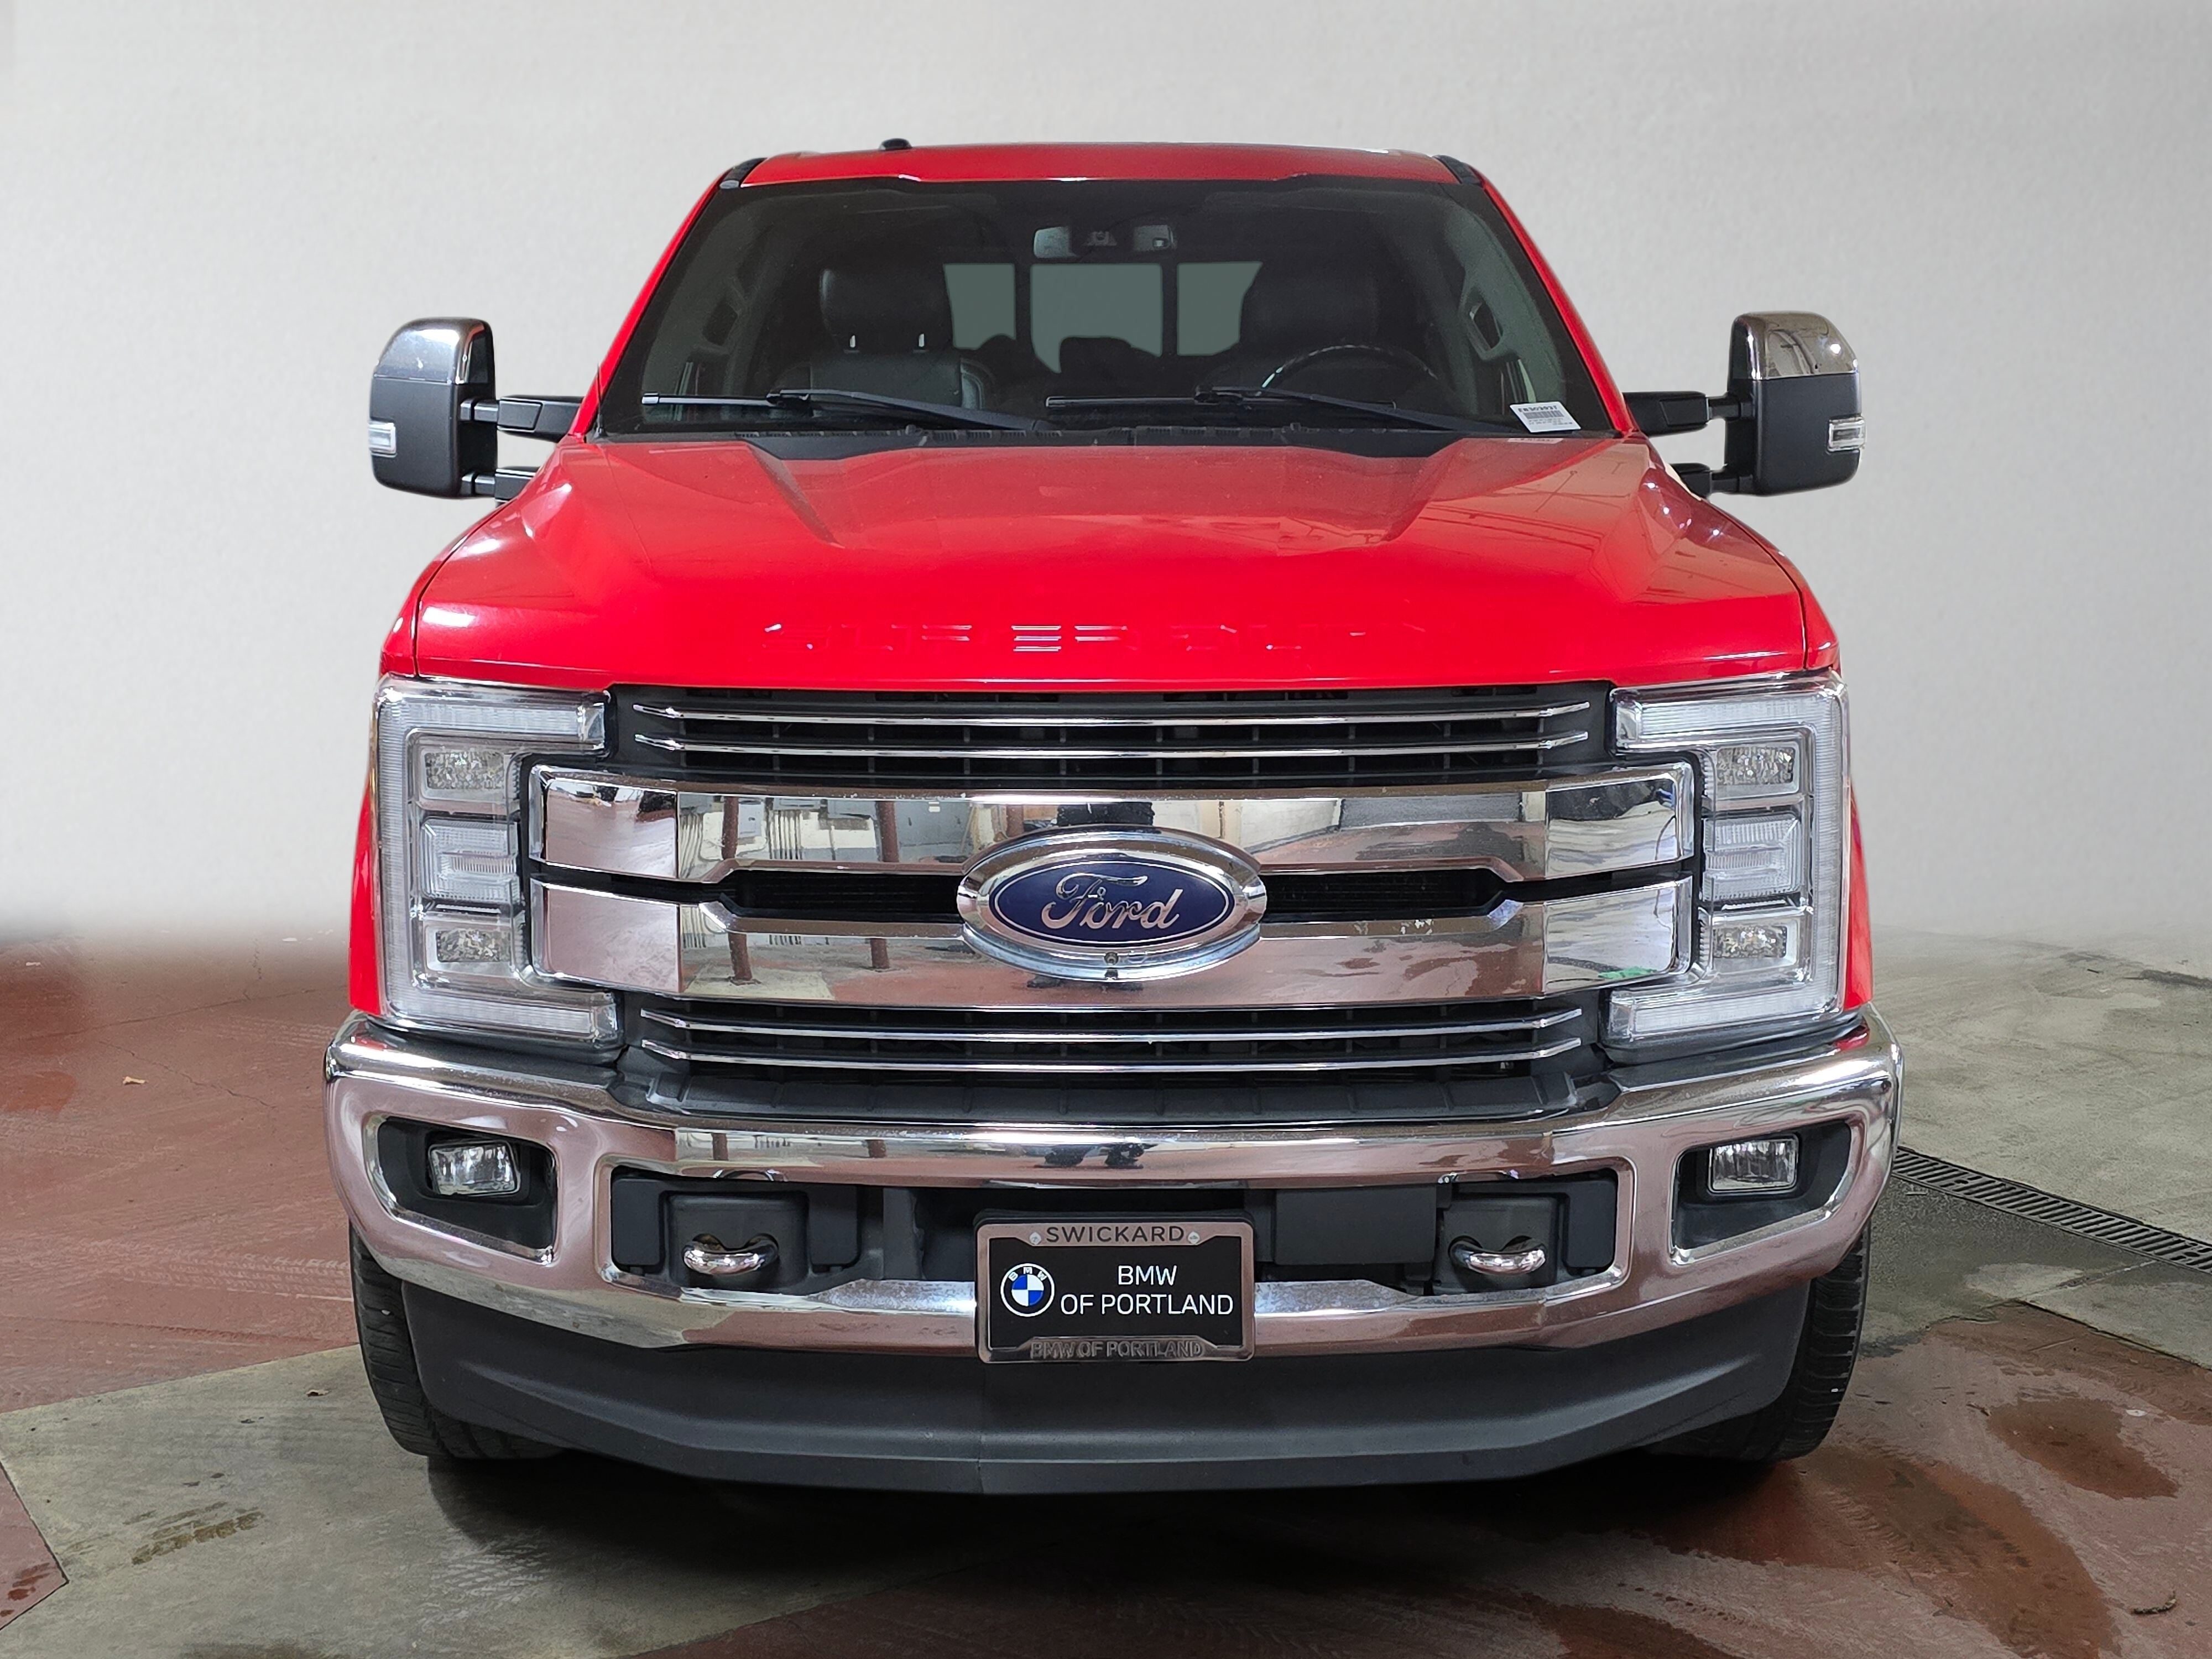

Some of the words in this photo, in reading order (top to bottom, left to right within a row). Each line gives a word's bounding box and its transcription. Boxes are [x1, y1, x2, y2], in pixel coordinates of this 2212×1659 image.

[1041, 872, 1183, 929] Ford
[1046, 1226, 1185, 1242] SWICKARD
[1118, 1265, 1177, 1286] BMW
[1061, 1293, 1094, 1315] OF
[1102, 1293, 1234, 1315] PORTLAND
[1030, 1340, 1076, 1359] BMW
[1078, 1340, 1103, 1358] OF
[1107, 1340, 1204, 1358] PORTLAND
